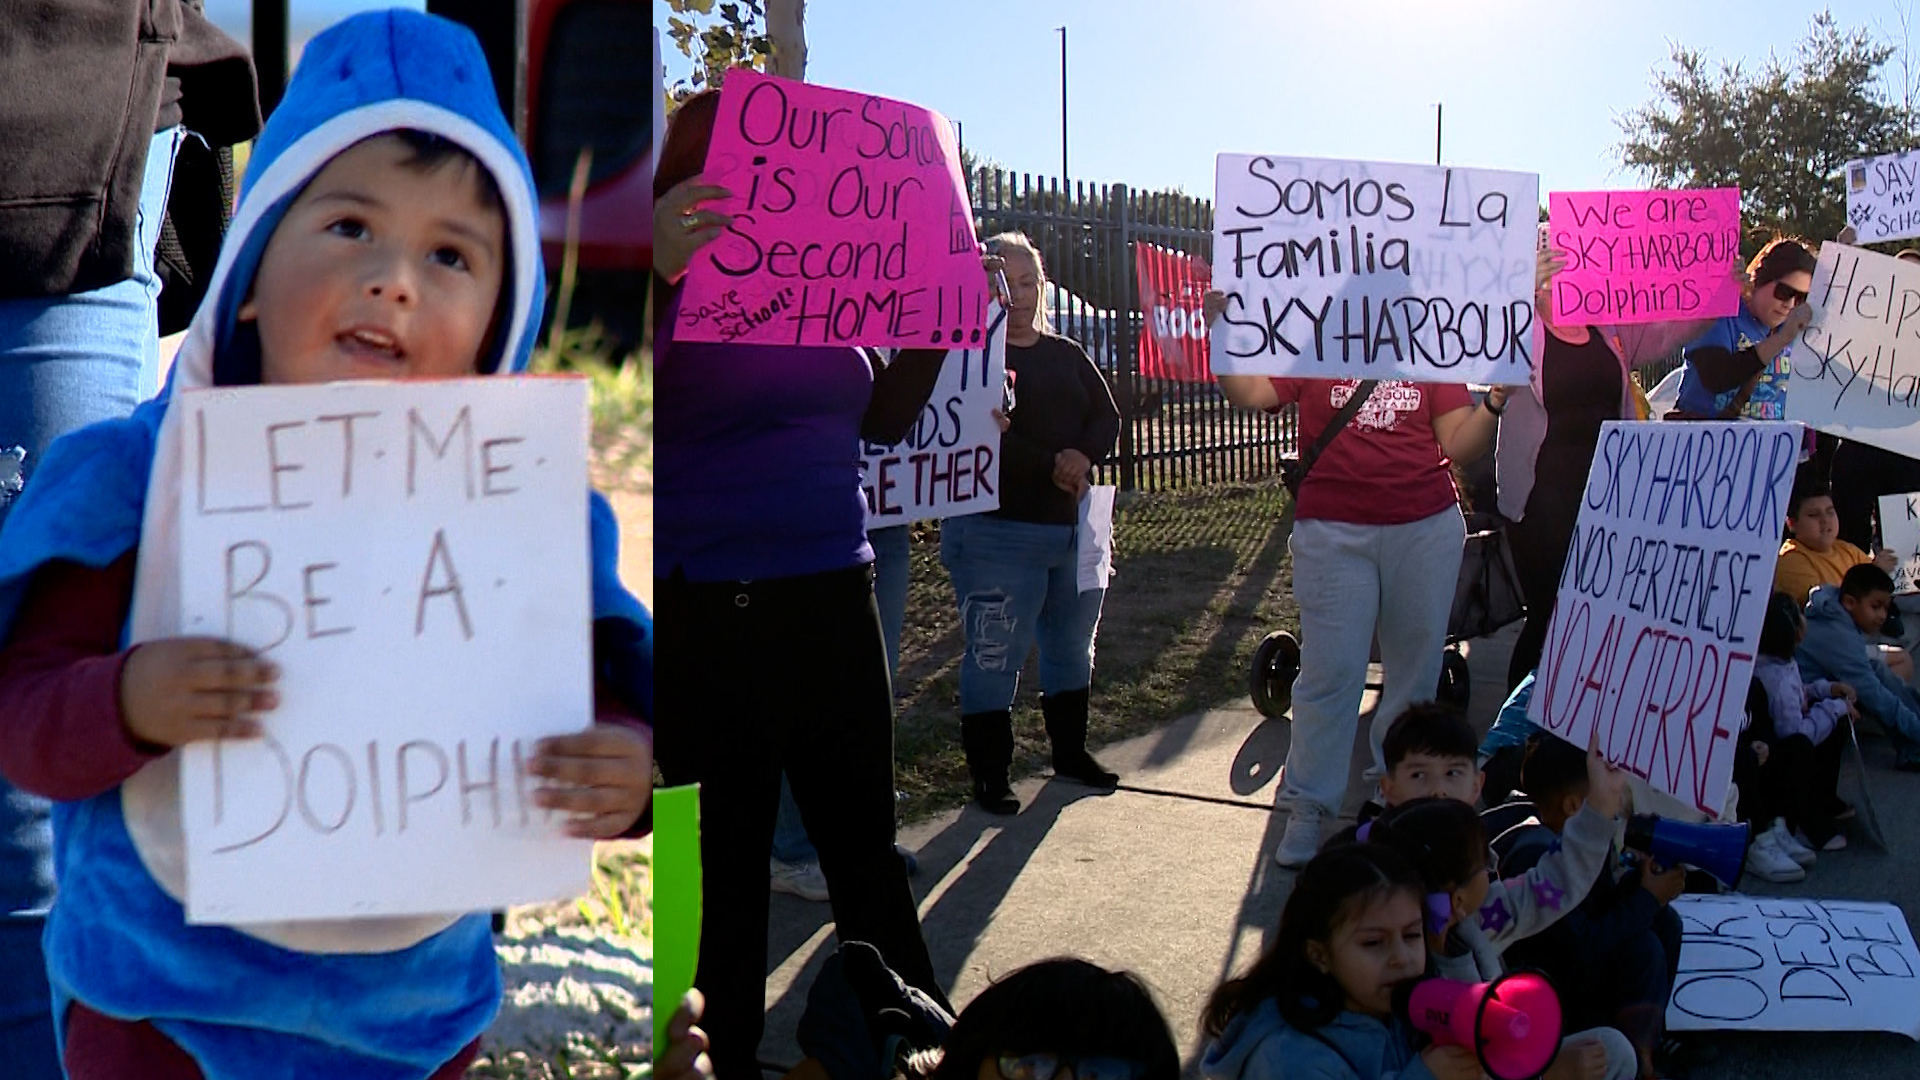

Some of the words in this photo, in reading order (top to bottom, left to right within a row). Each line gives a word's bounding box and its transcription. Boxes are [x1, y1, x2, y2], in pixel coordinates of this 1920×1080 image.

[739, 81, 852, 153] Our
[746, 157, 797, 213] is
[828, 166, 925, 221] Our
[1236, 157, 1415, 222] Somos
[1439, 169, 1508, 228] La
[1566, 193, 1635, 229] We
[1647, 197, 1708, 223] are
[1892, 189, 1914, 207] MY
[710, 214, 908, 281] Second
[1558, 279, 1701, 318] Dolphins
[1821, 253, 1920, 338] Help
[196, 408, 382, 515] LET
[405, 404, 527, 502] ME
[223, 540, 356, 655] BE
[414, 528, 475, 641] A
[1561, 525, 1618, 599] NOS
[1617, 535, 1761, 643] PERTENESE
[1543, 595, 1591, 729] NO
[1607, 626, 1753, 820] CIERRE
